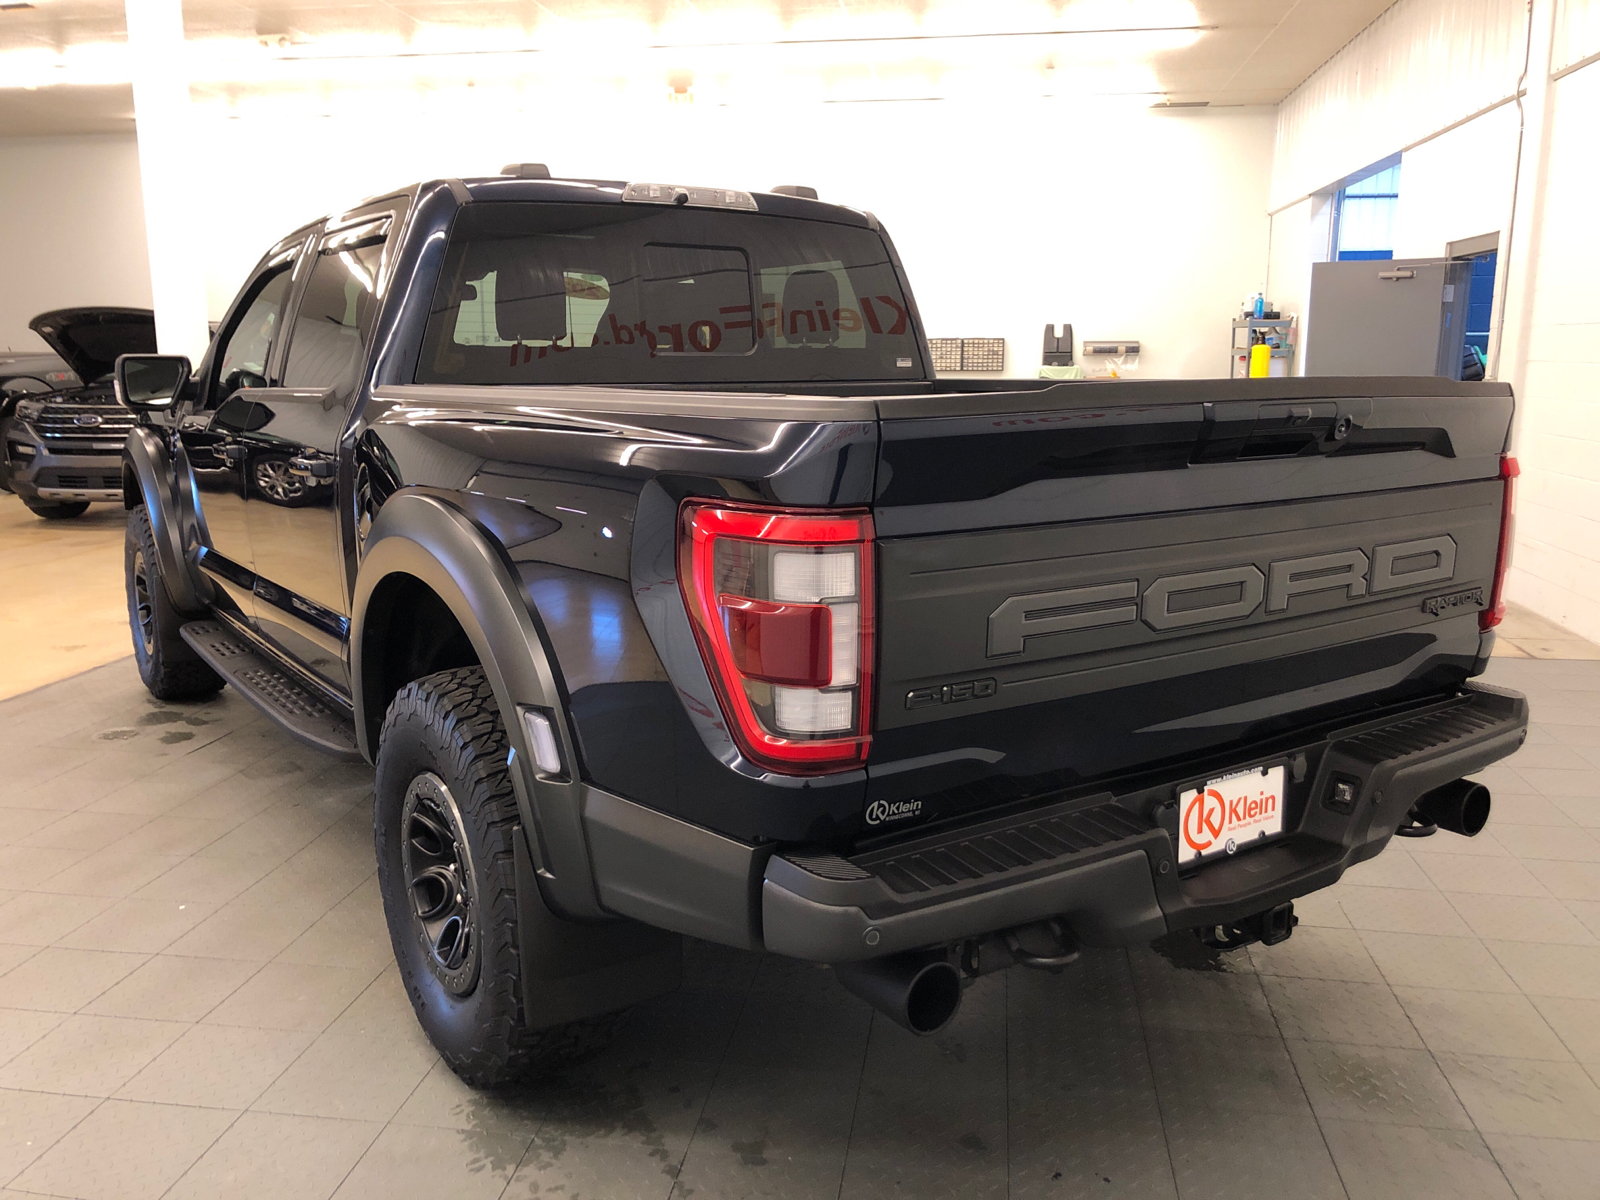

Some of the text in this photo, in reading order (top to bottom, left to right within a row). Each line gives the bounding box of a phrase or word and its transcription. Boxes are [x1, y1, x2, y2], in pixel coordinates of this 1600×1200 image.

[986, 533, 1458, 660] FORD
[1421, 586, 1484, 616] RAPTOR
[904, 677, 998, 711] F-150
[1206, 766, 1264, 786] www.kleinauto.com
[889, 799, 922, 815] Klein
[1228, 791, 1276, 824] Klein
